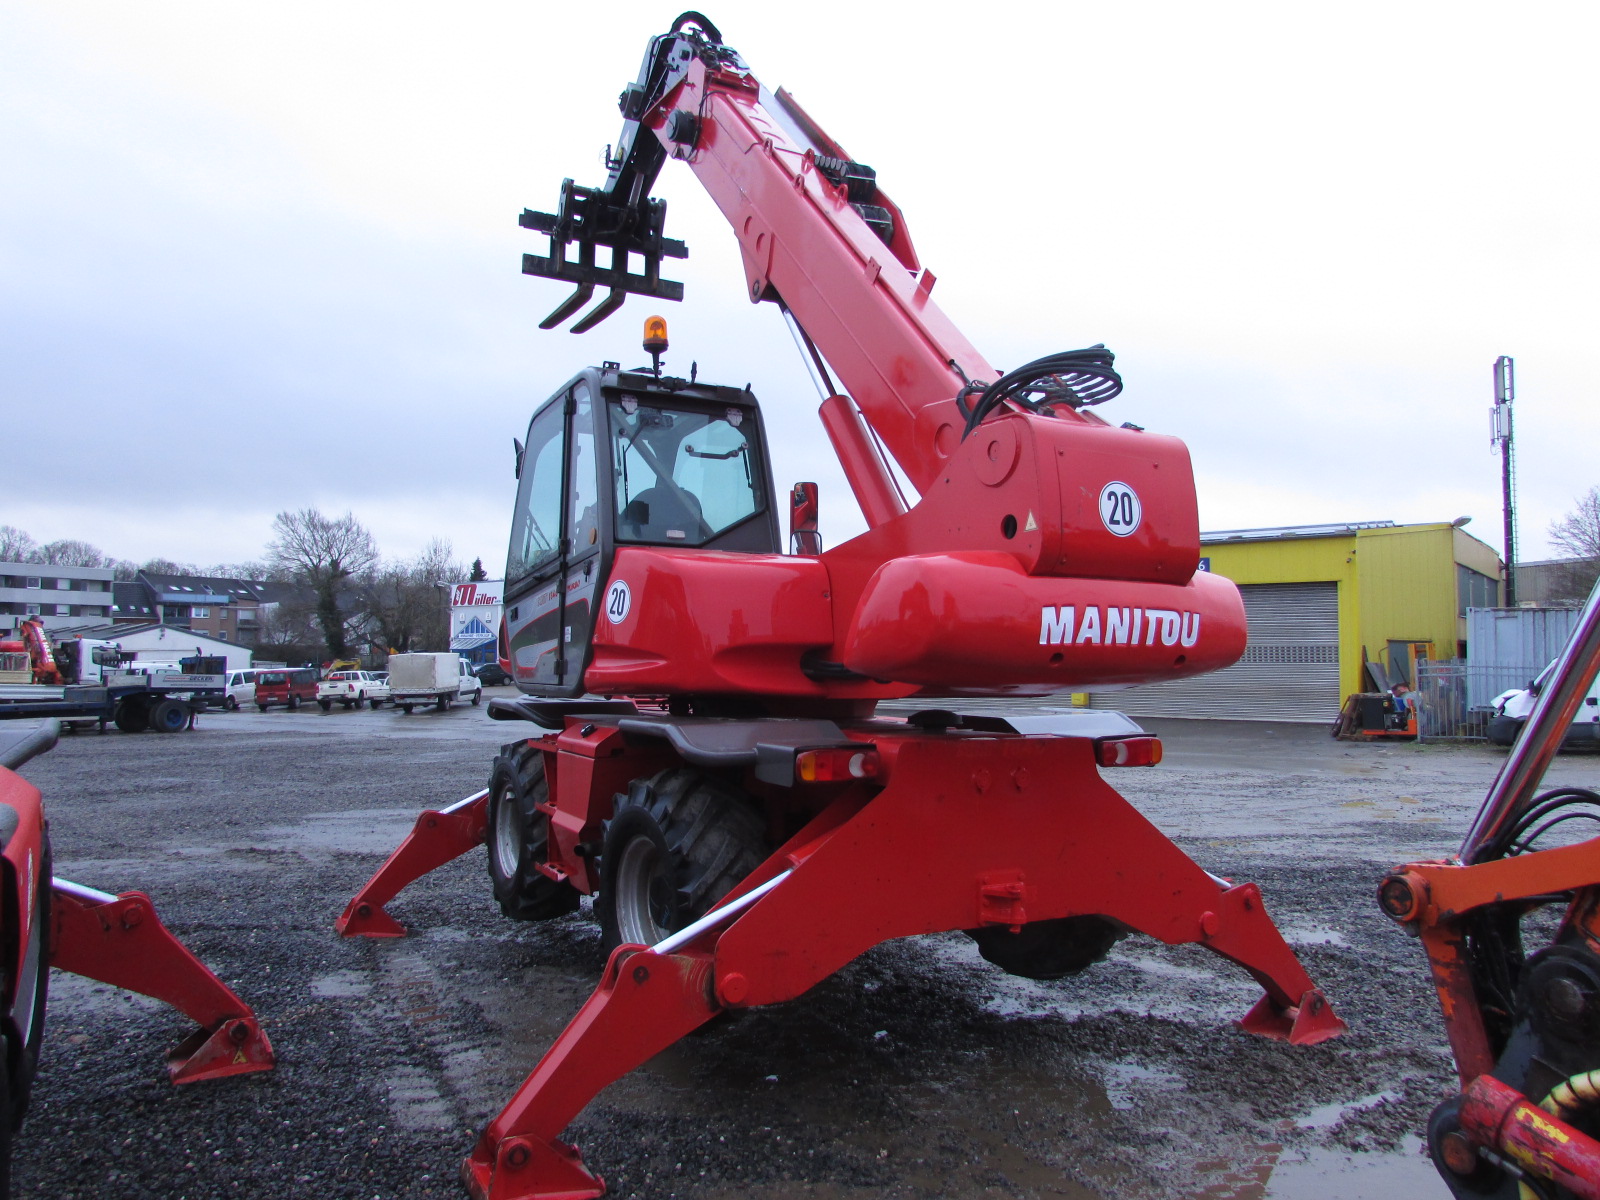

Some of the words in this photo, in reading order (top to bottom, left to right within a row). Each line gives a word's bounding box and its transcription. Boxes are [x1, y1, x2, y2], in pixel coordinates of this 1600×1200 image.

[1107, 490, 1134, 526] 20
[453, 583, 497, 606] Müller
[609, 587, 626, 616] 20
[1039, 605, 1200, 648] MANITOU
